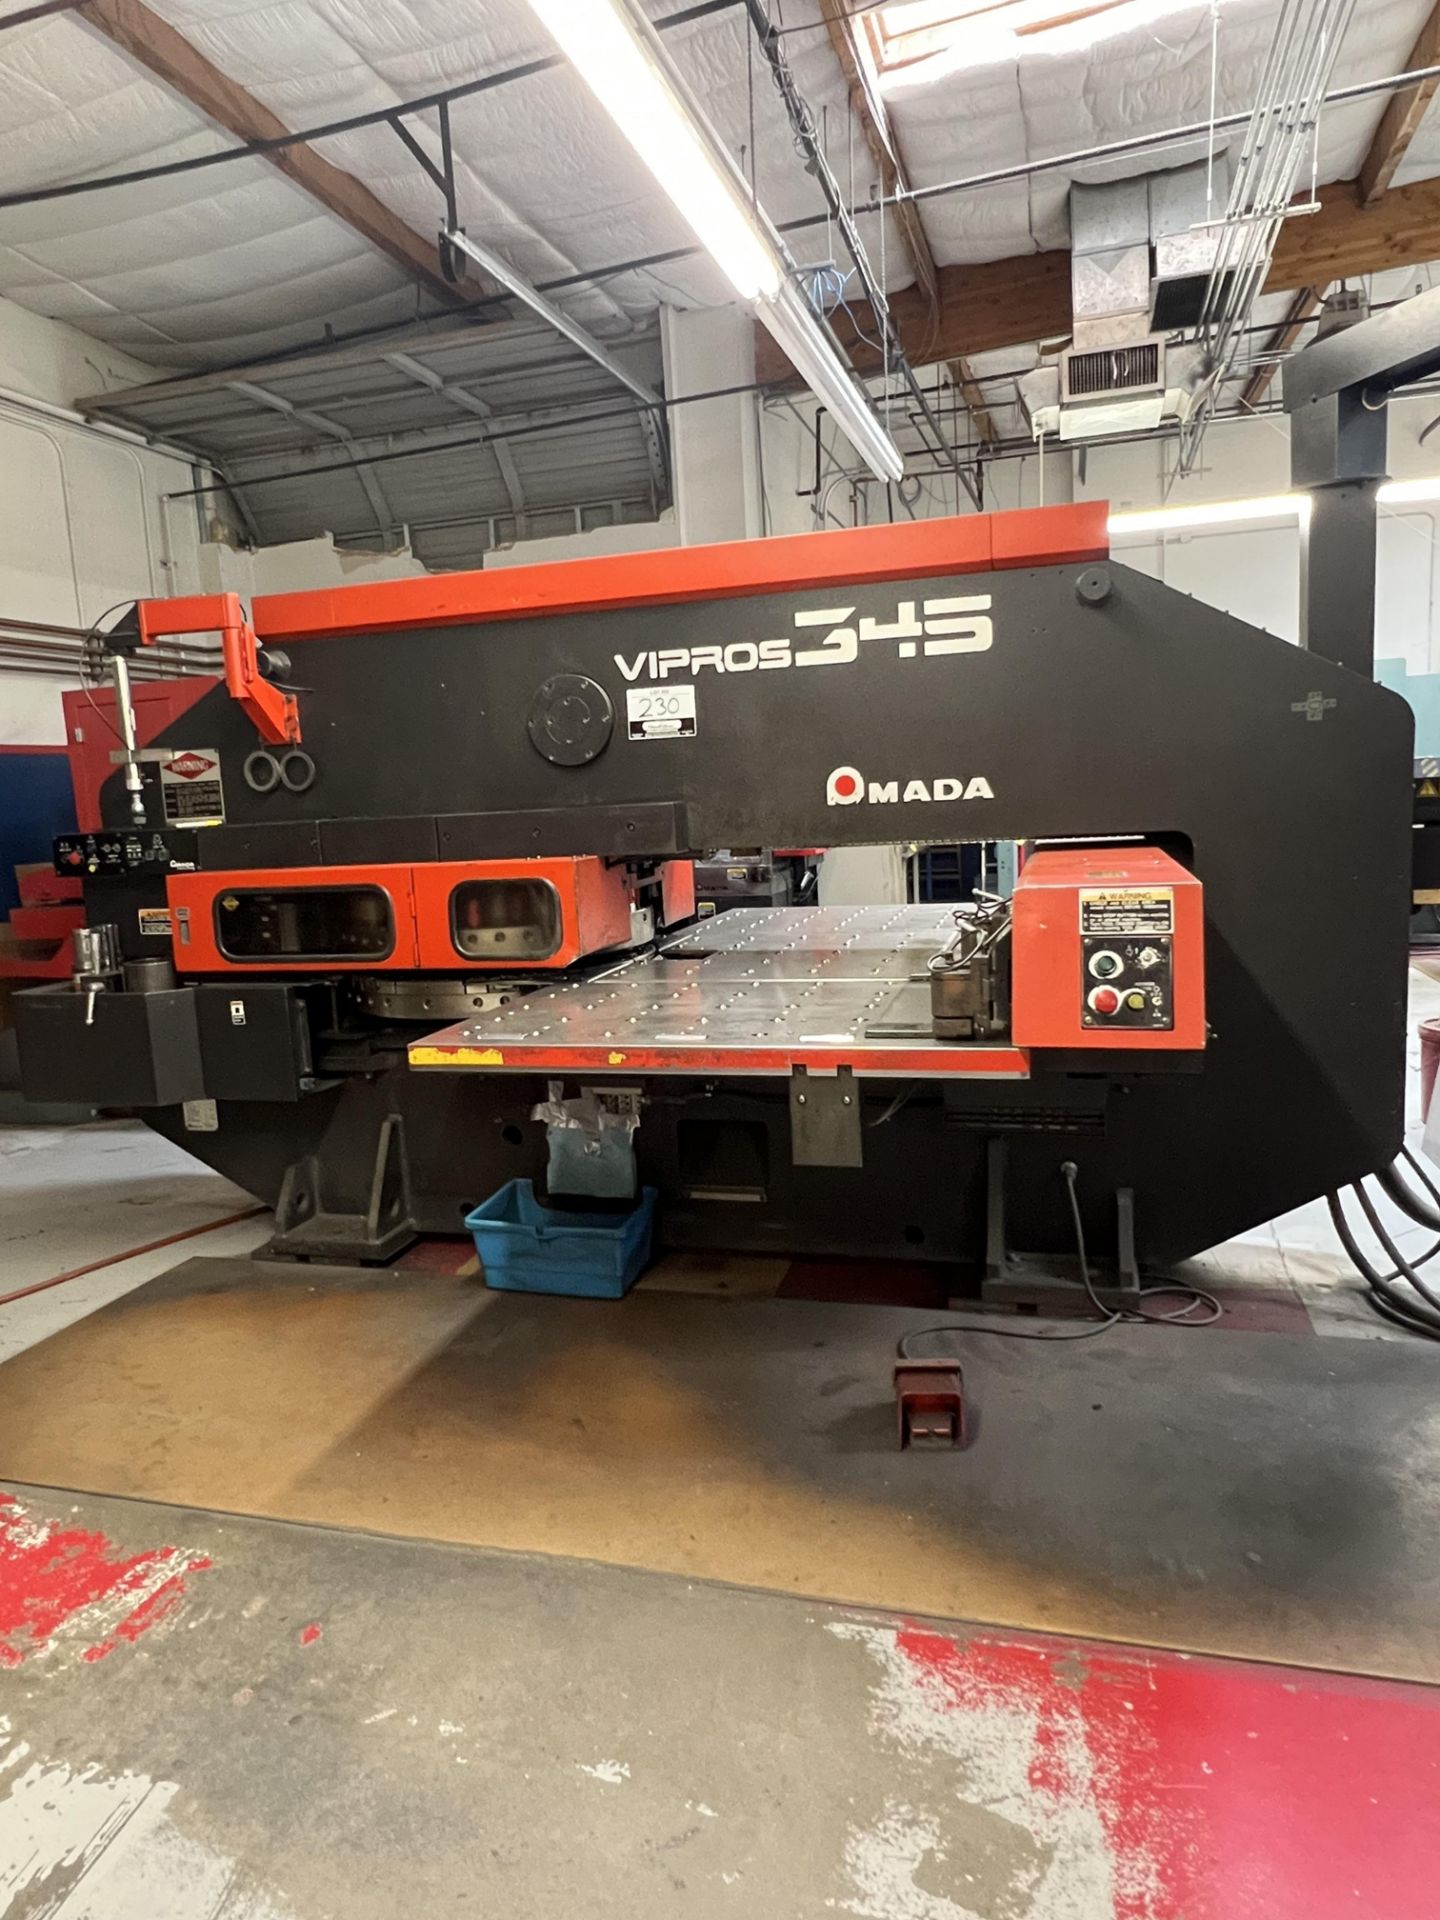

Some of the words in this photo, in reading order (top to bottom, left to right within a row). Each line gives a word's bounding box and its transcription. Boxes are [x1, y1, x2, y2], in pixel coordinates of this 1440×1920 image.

[614, 639, 792, 680] VIPROS
[794, 594, 993, 667] 345
[639, 697, 680, 719] 230
[827, 766, 995, 806] AMADA
